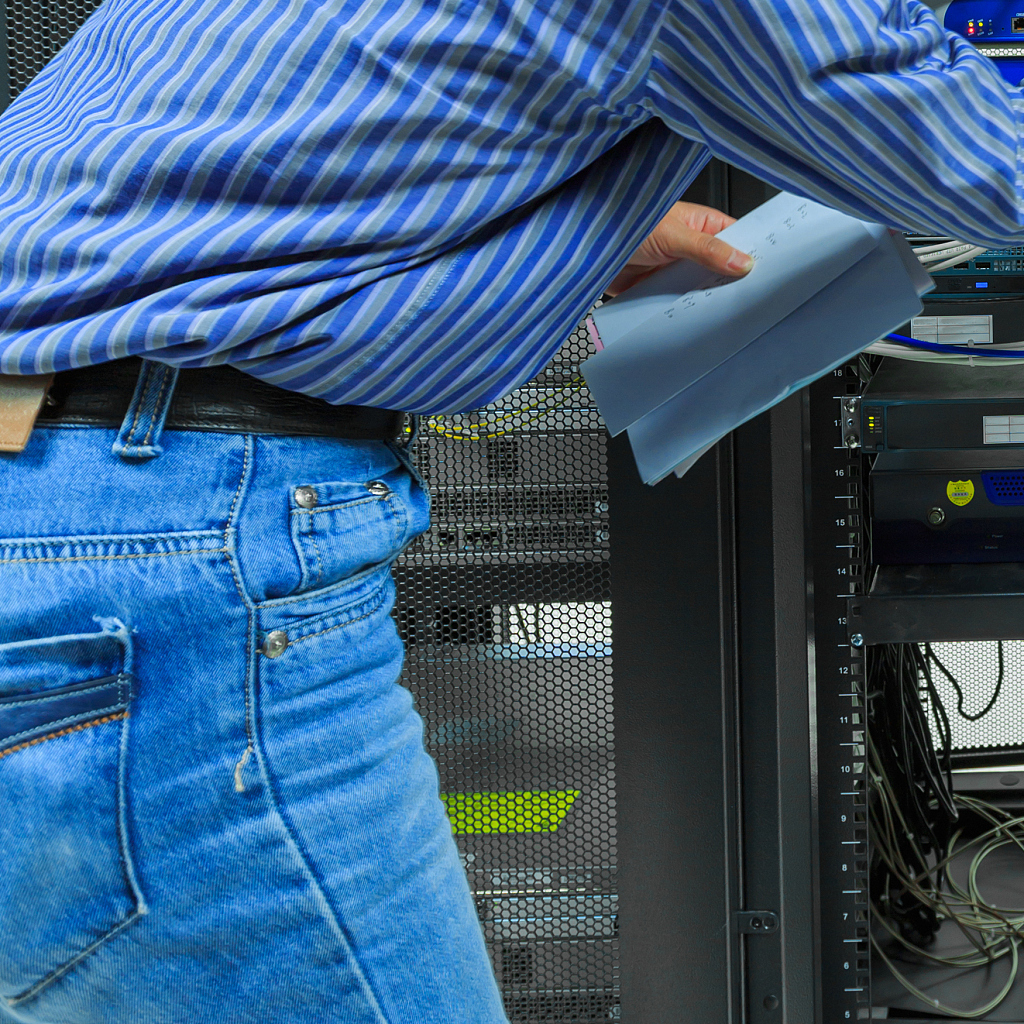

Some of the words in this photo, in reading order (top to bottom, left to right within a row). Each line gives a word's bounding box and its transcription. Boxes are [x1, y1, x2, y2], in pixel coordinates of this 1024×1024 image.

[833, 369, 844, 378] 18
[834, 469, 845, 477] 16
[835, 518, 846, 527] 15
[837, 567, 847, 575] 14
[837, 617, 847, 625] 13
[838, 666, 849, 675] 12
[839, 716, 848, 724] 11
[840, 765, 851, 773] 10
